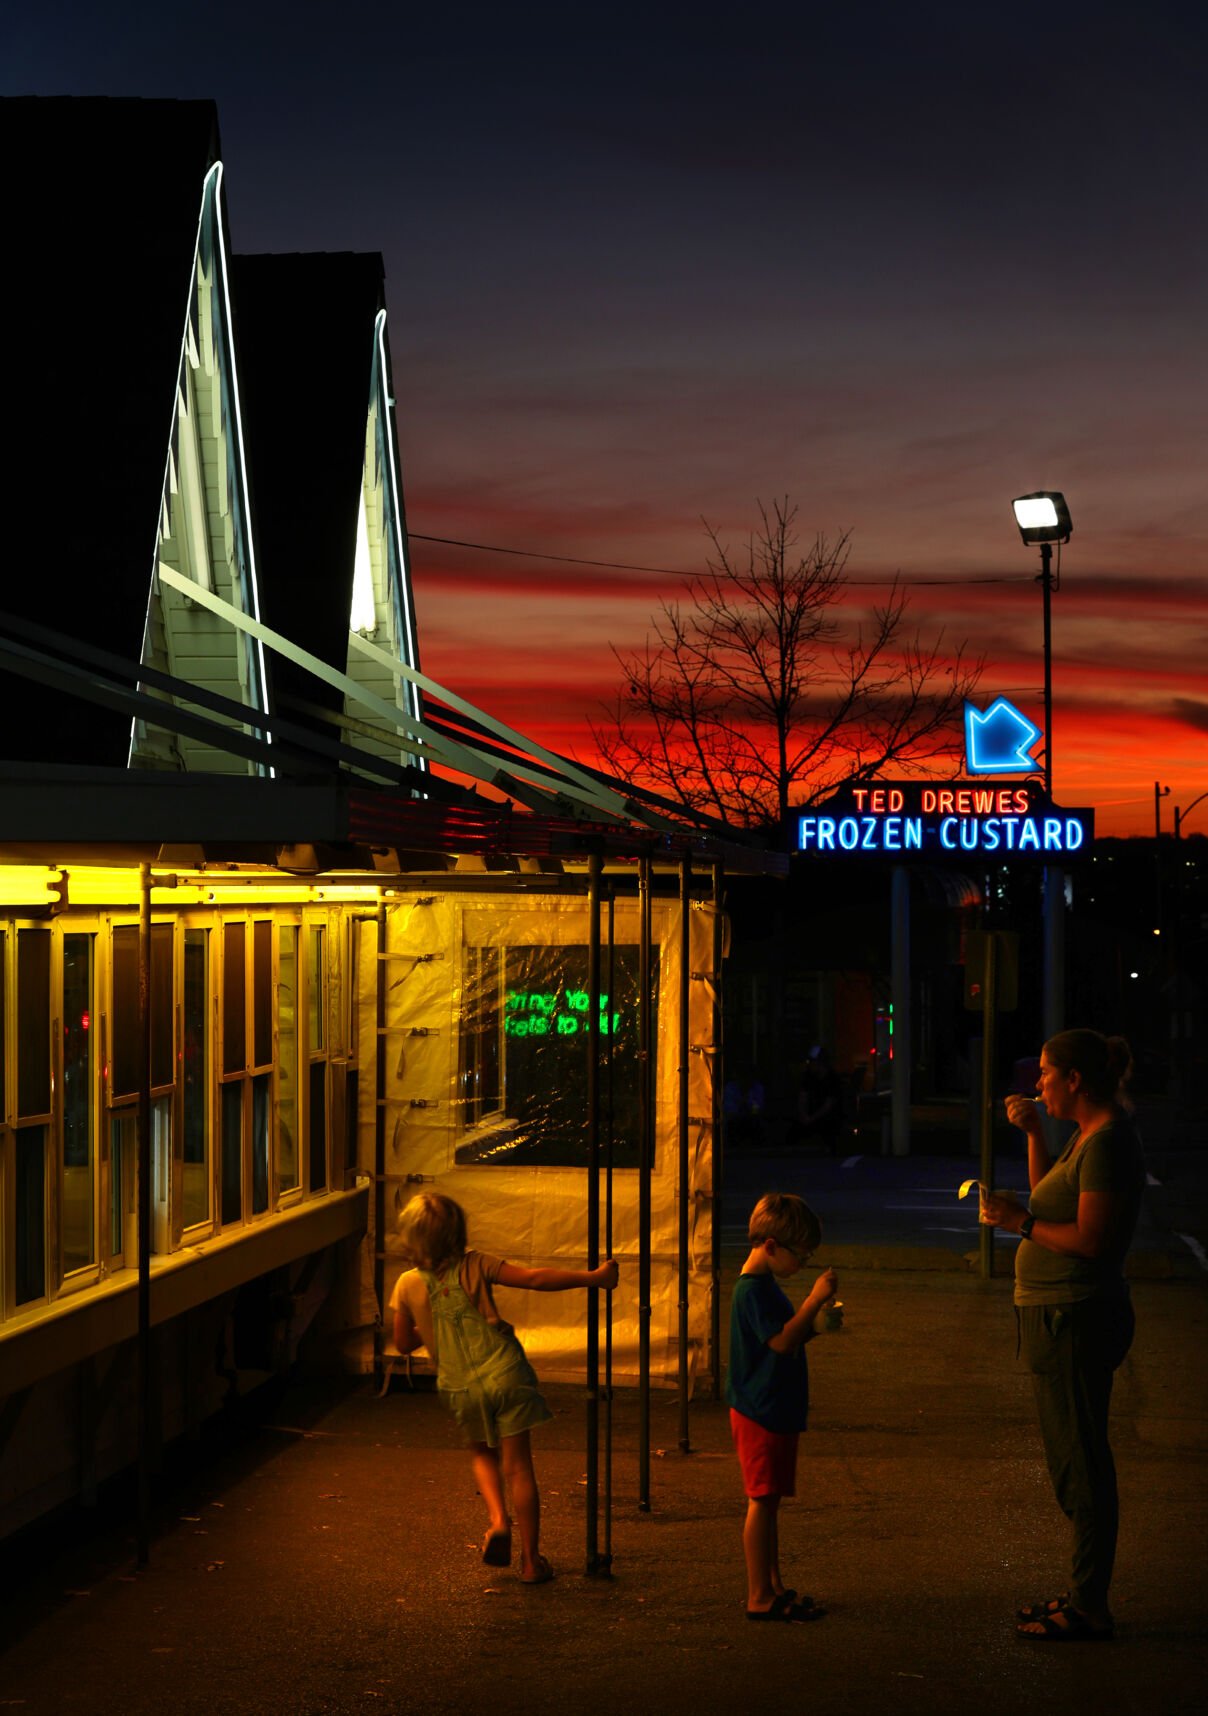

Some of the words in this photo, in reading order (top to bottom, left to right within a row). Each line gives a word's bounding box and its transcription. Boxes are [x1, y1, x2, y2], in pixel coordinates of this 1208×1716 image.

[853, 789, 904, 813] TED
[922, 789, 1030, 813] DREWES
[798, 816, 923, 850] FROZEN
[939, 816, 1085, 850] CUSTARD
